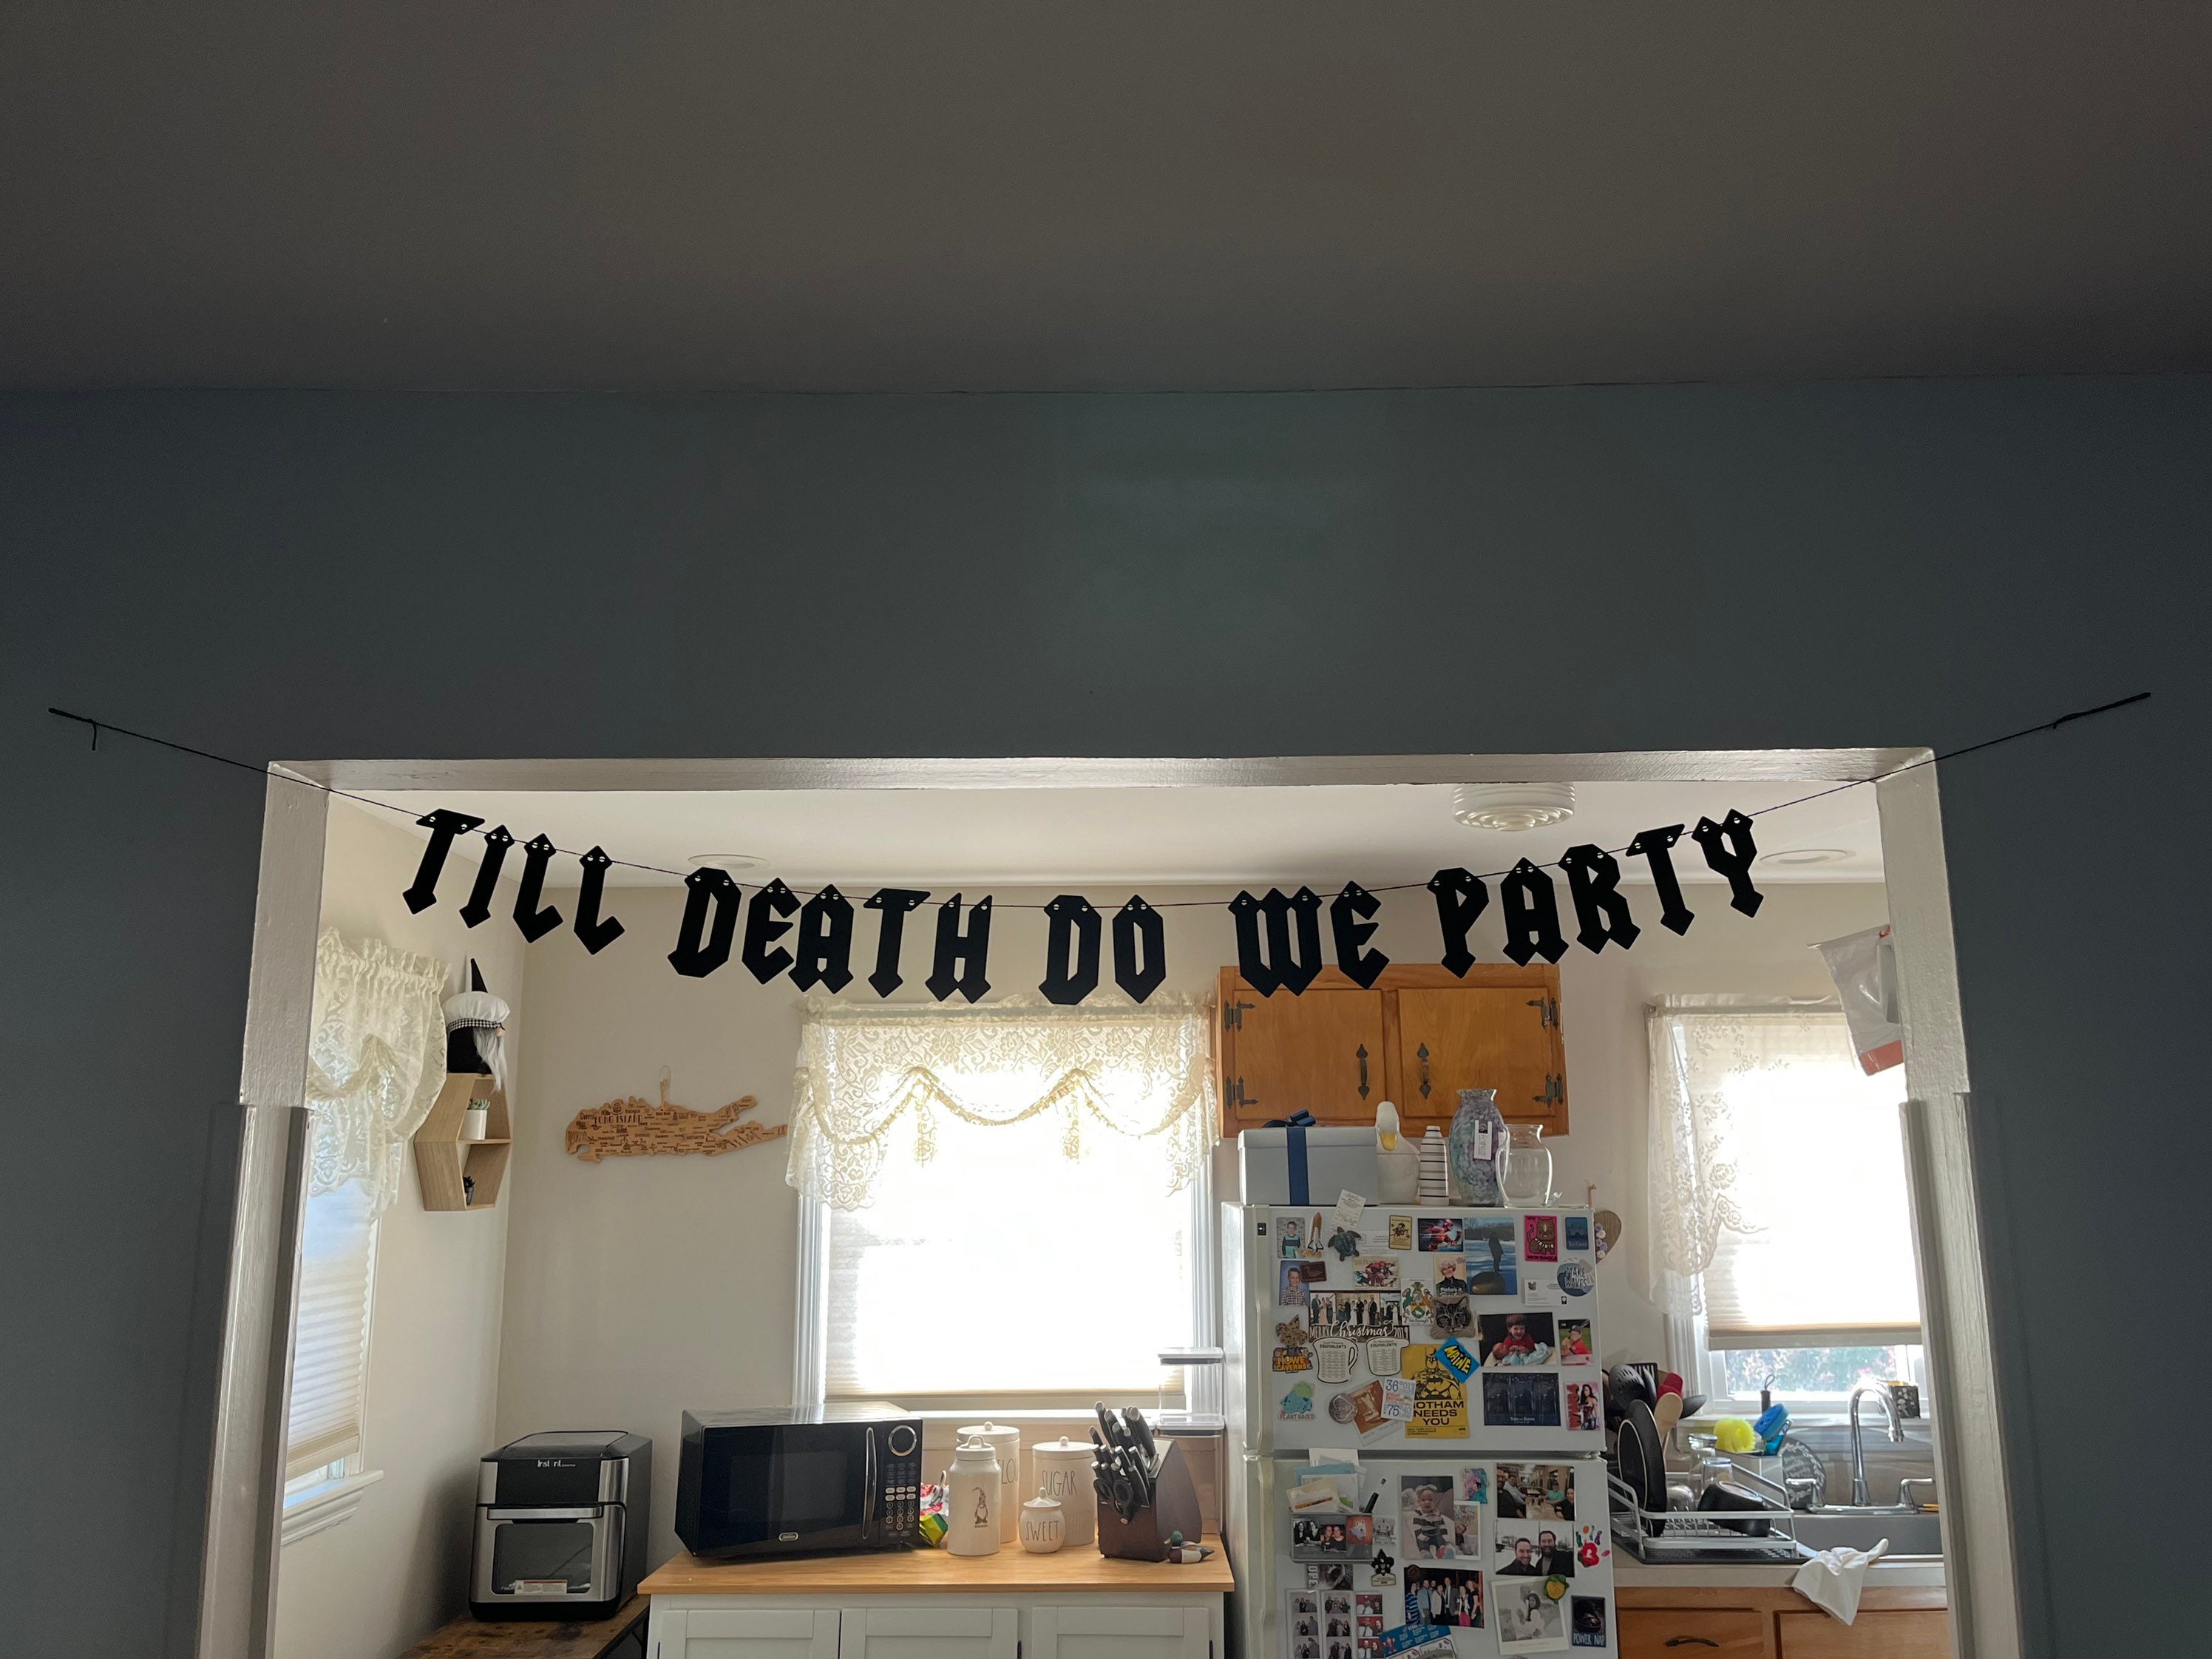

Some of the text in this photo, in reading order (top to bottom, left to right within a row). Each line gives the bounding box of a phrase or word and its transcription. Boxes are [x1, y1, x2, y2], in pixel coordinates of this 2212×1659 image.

[402, 809, 1764, 1005] TILL DEATH DO WE PARTY
[1564, 1266, 1587, 1289] MAKE WAVES
[1309, 1327, 1331, 1338] MERRY
[1330, 1320, 1394, 1338] Christmas
[1277, 1356, 1306, 1365] HOWE
[1277, 1364, 1308, 1372] CAVERNS
[1414, 1409, 1457, 1417] NEEDS
[1042, 1470, 1078, 1496] SUGAR
[1025, 1521, 1059, 1541] SWEET
[1573, 1633, 1605, 1646] POWER NAP
